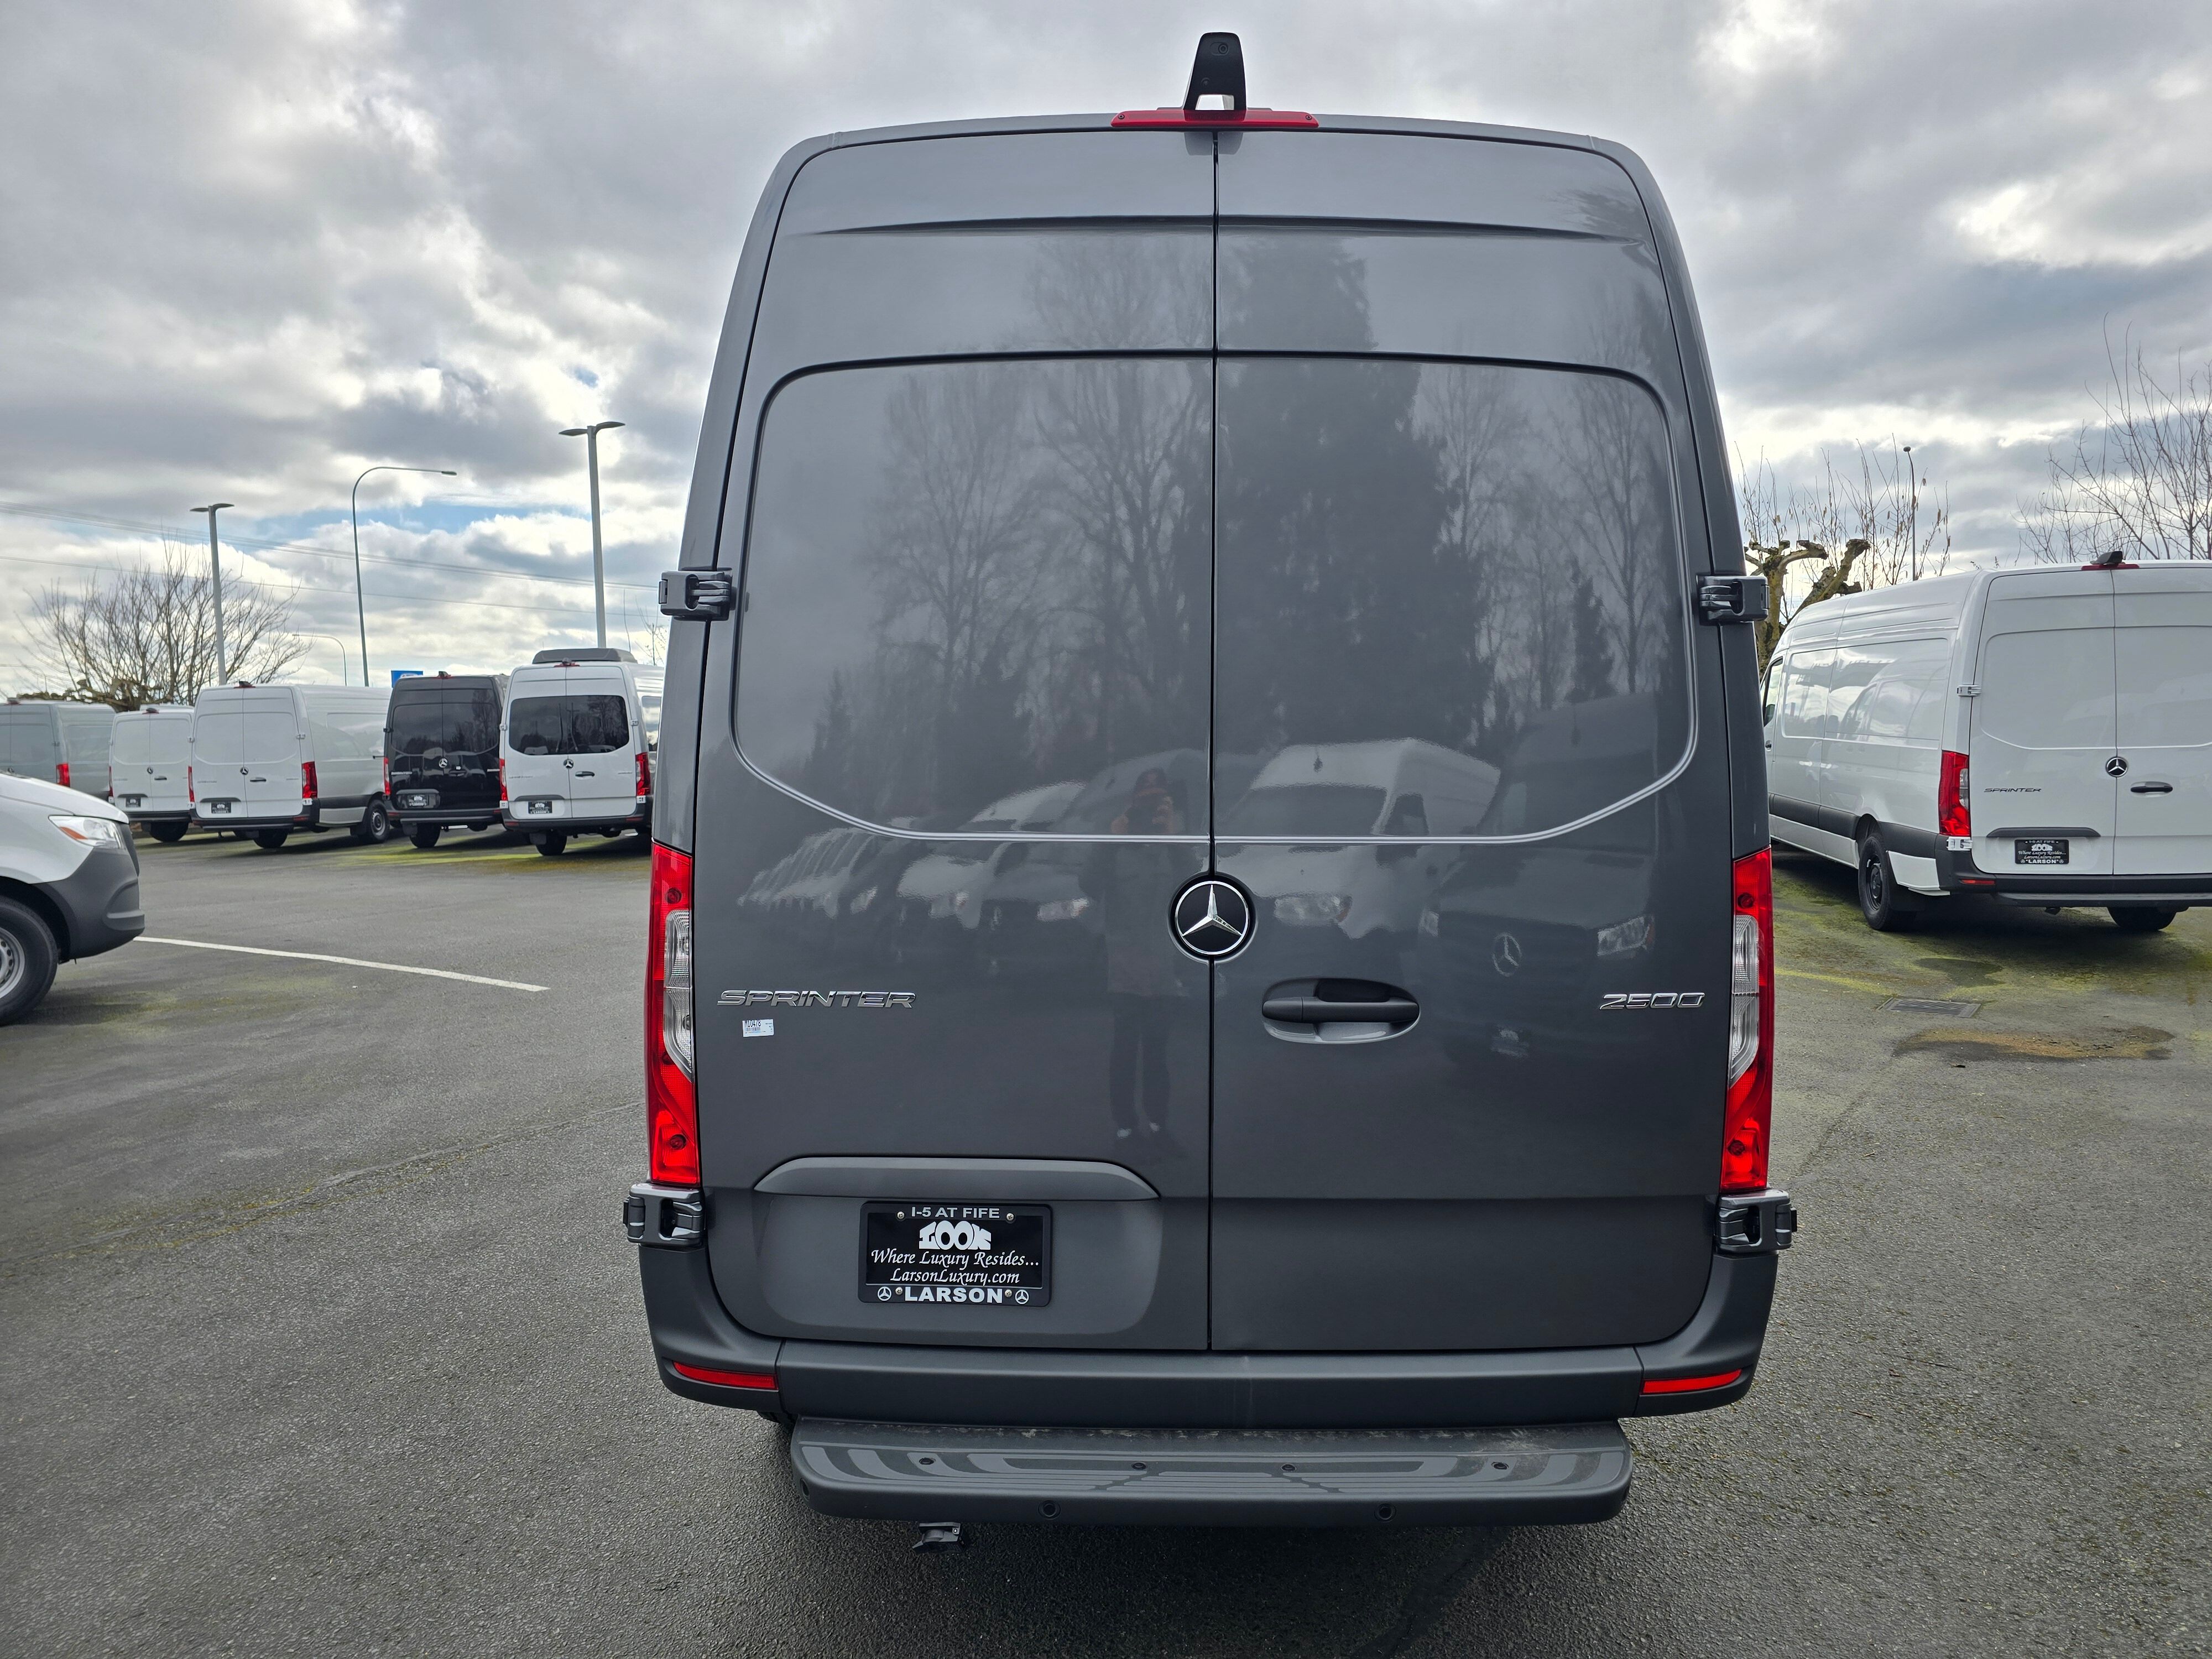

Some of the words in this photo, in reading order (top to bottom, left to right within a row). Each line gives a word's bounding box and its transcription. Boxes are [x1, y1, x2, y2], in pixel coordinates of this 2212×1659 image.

[717, 990, 916, 1008] SPRINTER
[1599, 993, 1705, 1010] 2500
[912, 1207, 931, 1217] I-5
[935, 1208, 957, 1218] AT
[963, 1208, 1000, 1218] FIFE
[871, 1248, 916, 1264] Where
[919, 1251, 969, 1270] Luxury
[973, 1250, 1039, 1267] Resides...
[890, 1268, 1020, 1286] LarsonLuxury.com
[905, 1286, 1003, 1303] LARSON
